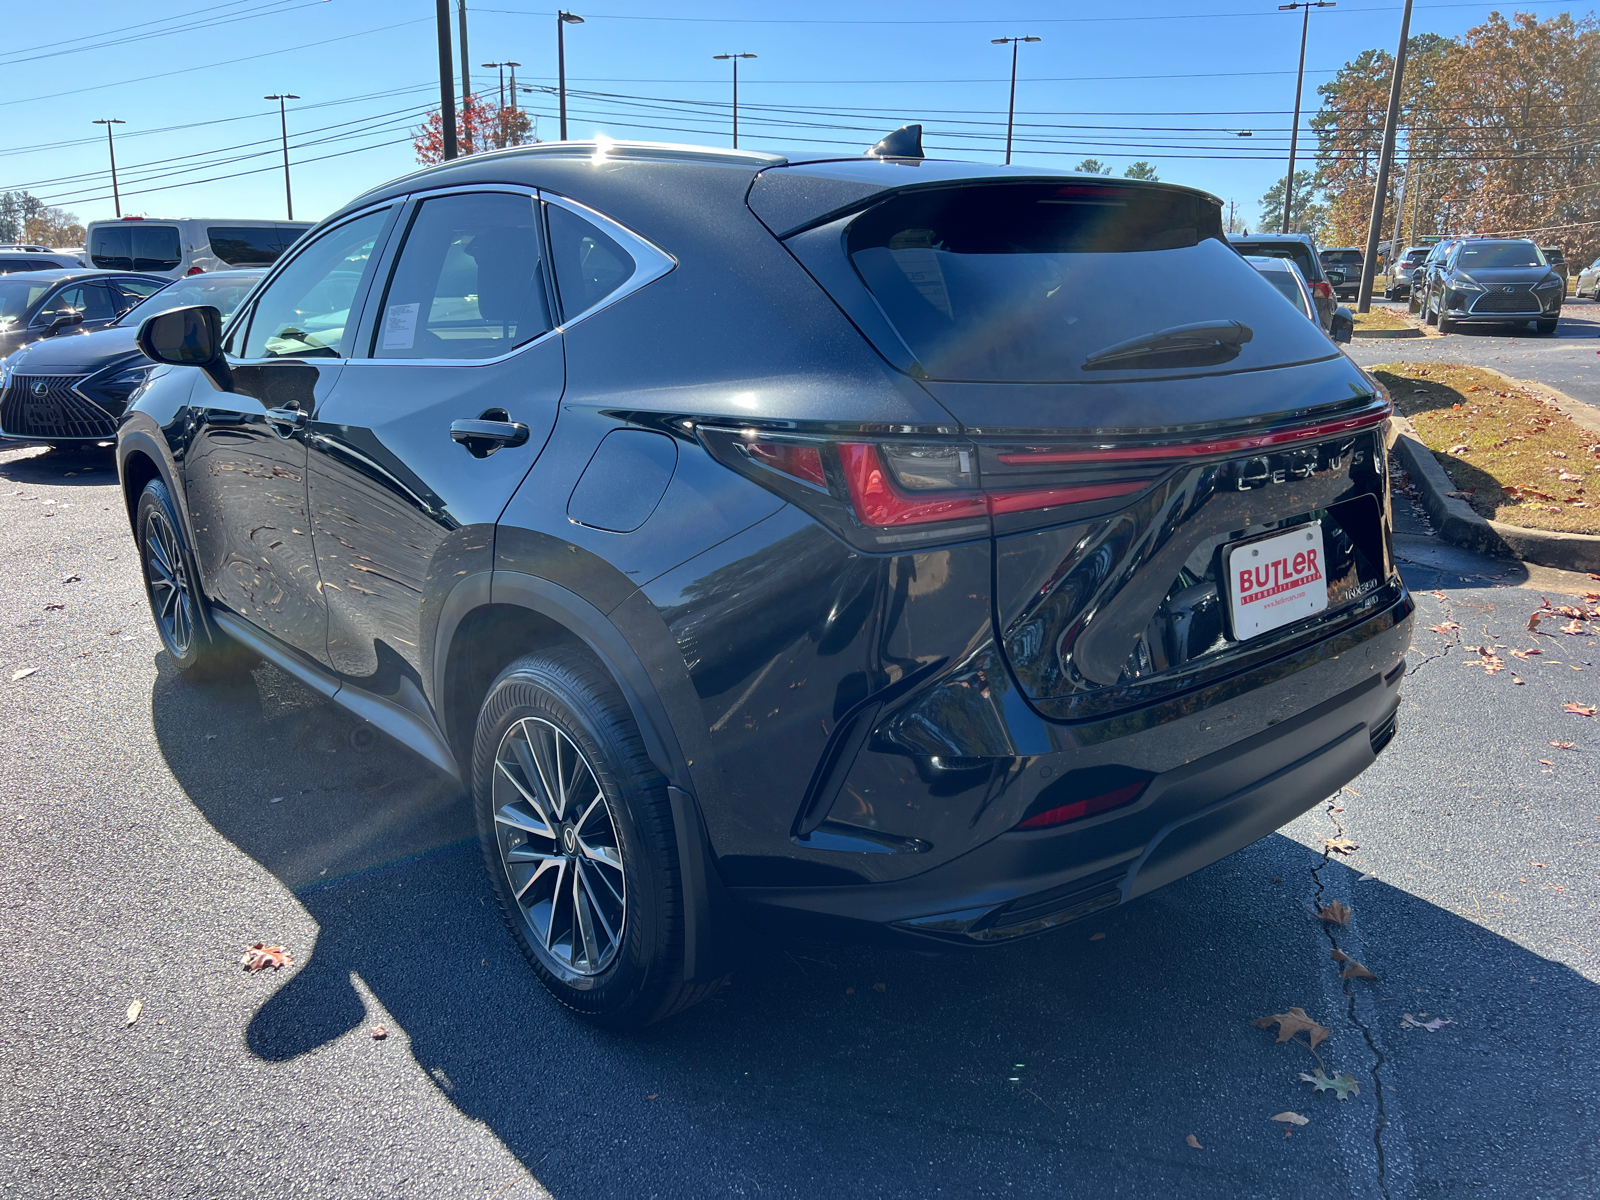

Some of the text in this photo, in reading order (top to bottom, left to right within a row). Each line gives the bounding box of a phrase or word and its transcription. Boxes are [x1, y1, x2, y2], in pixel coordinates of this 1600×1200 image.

[1237, 451, 1364, 491] LEXUS
[1241, 572, 1321, 605] AUTOMOTIVE GROUP
[1263, 591, 1306, 609] www.butlercars.com
